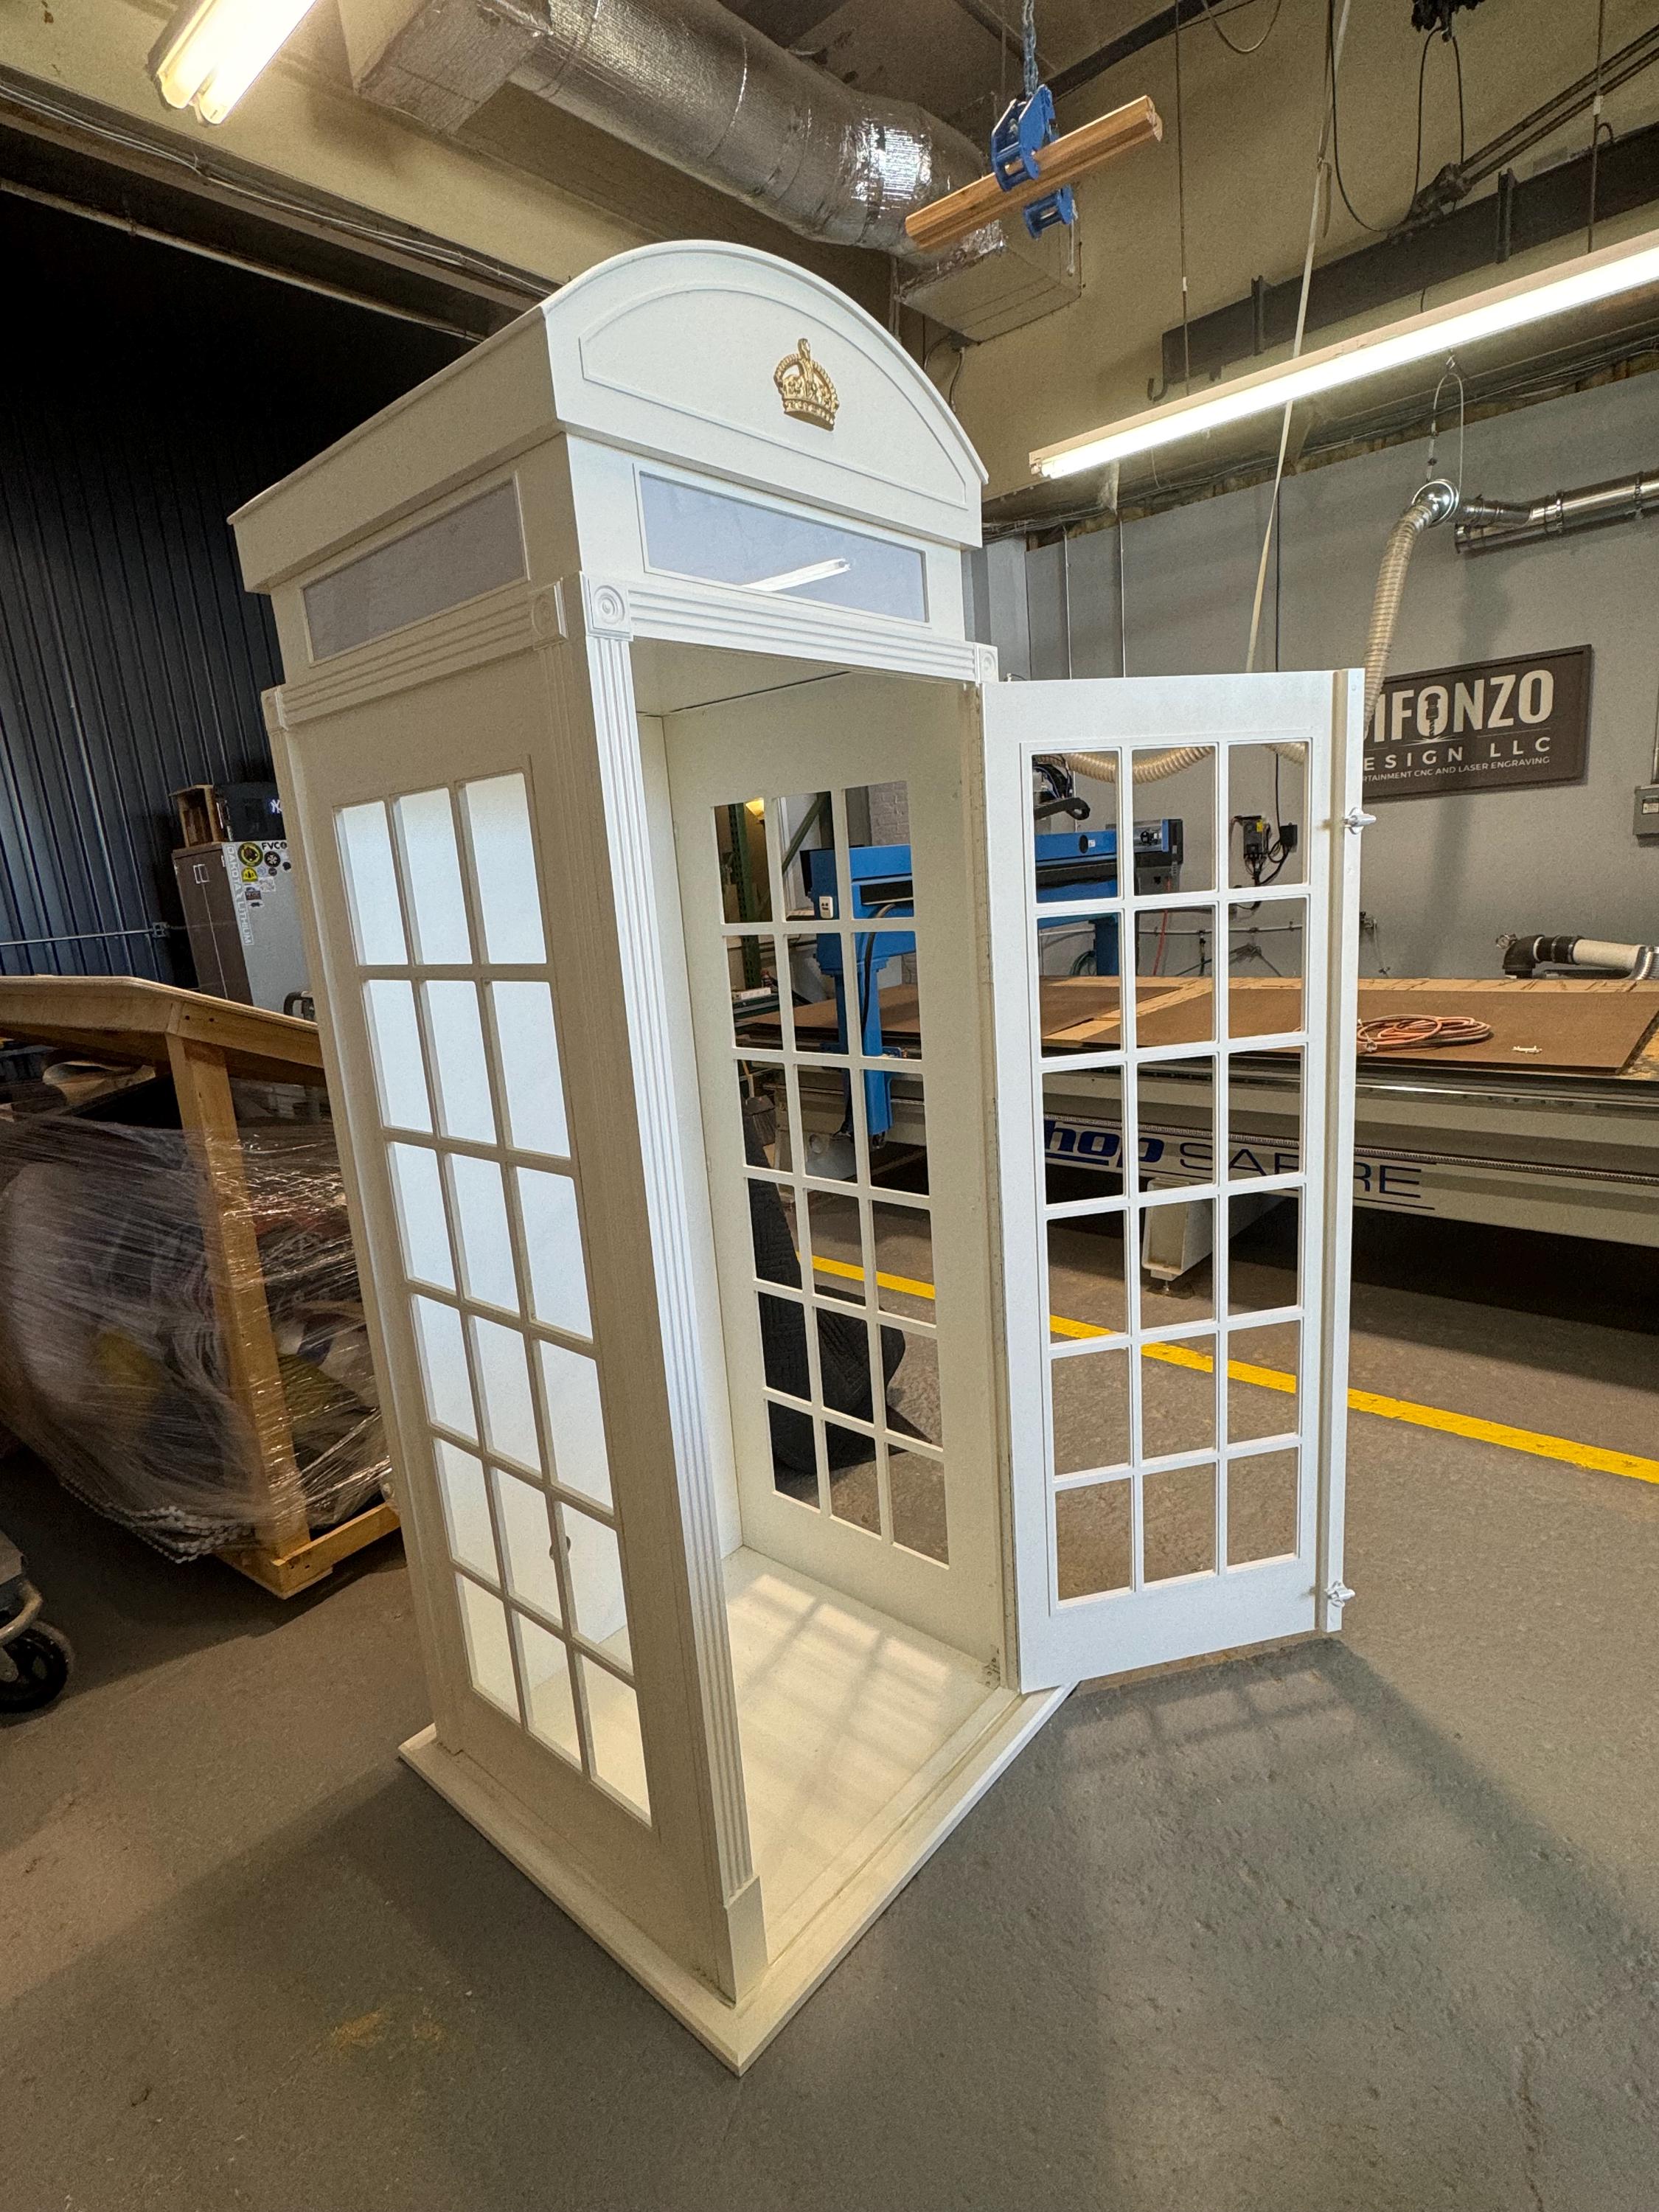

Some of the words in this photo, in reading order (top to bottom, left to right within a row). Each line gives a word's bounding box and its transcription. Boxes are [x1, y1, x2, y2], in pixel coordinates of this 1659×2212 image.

[1364, 669, 1554, 742] IFONZO
[1363, 746, 1463, 771] ESIGN
[1489, 737, 1551, 758] LLC
[1363, 771, 1412, 782] RTAINMENT
[1413, 768, 1433, 777] CNC
[1435, 766, 1456, 776] AND
[1458, 762, 1489, 773] LASER
[1490, 756, 1551, 770] ENGRAVING
[226, 845, 242, 891] DAKOTA
[237, 901, 253, 945] LITHIUM
[1044, 1120, 1165, 1168] hop
